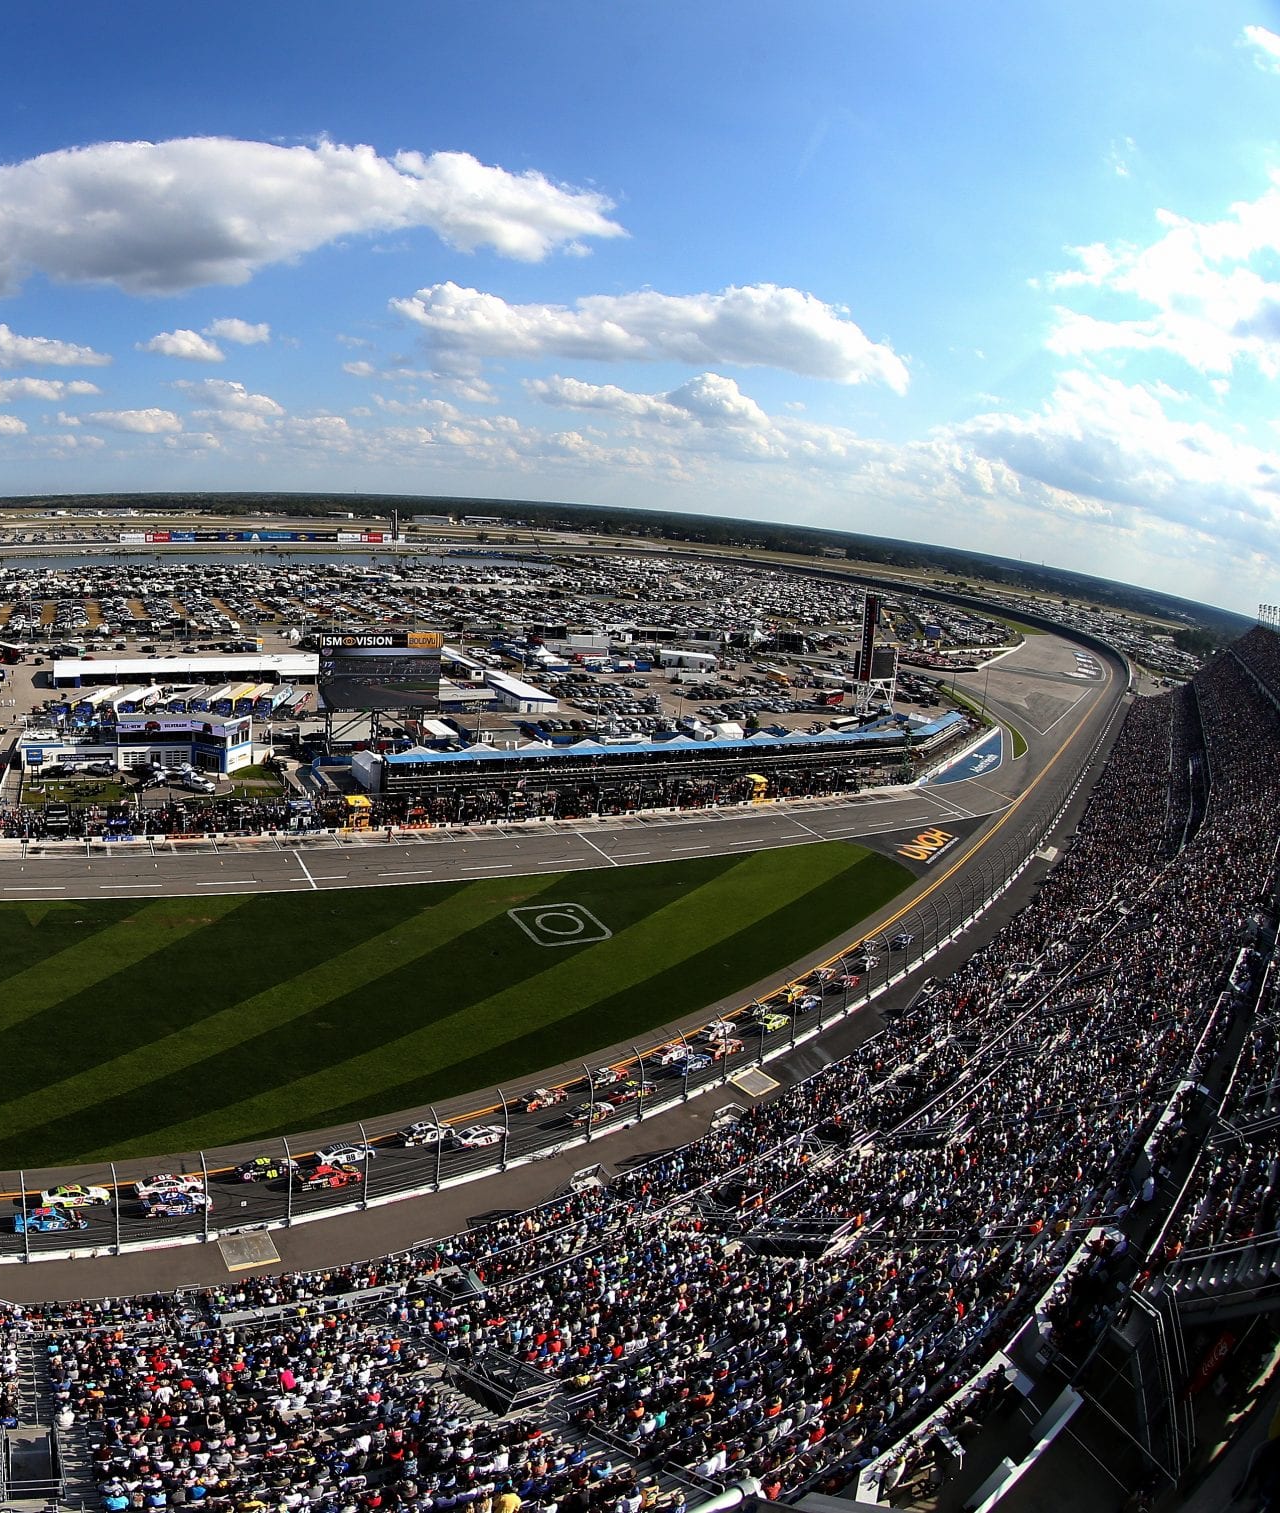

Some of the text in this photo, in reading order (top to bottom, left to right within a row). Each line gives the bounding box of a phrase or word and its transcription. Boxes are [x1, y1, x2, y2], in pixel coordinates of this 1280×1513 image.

[322, 636, 393, 646] ISM VISION
[896, 827, 954, 861] UNOH
[47, 1221, 59, 1229] 43
